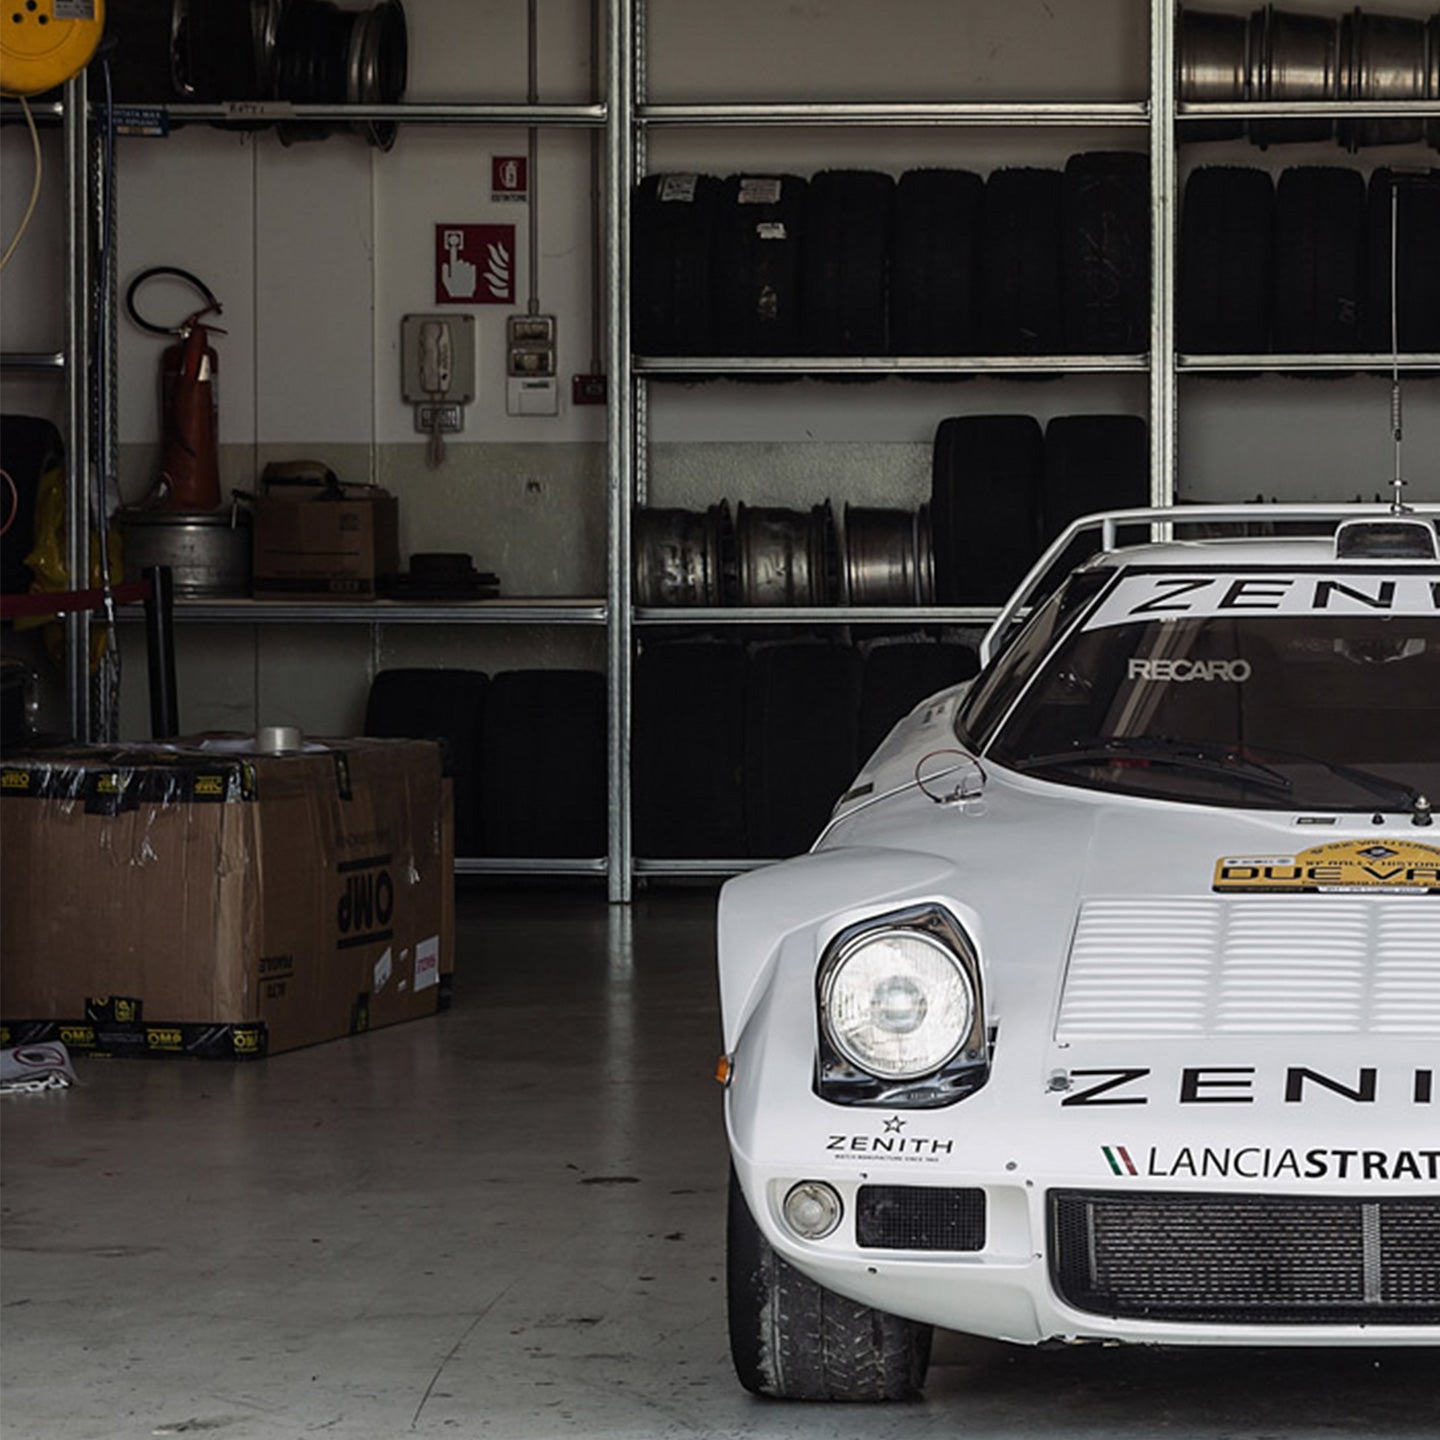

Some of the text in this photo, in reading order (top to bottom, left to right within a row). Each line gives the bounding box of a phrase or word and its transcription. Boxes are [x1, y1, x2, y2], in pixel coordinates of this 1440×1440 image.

[1128, 658, 1251, 683] RECARO
[1220, 866, 1342, 881] DUE
[338, 870, 394, 933] OMP
[826, 1135, 953, 1154] ZENITH
